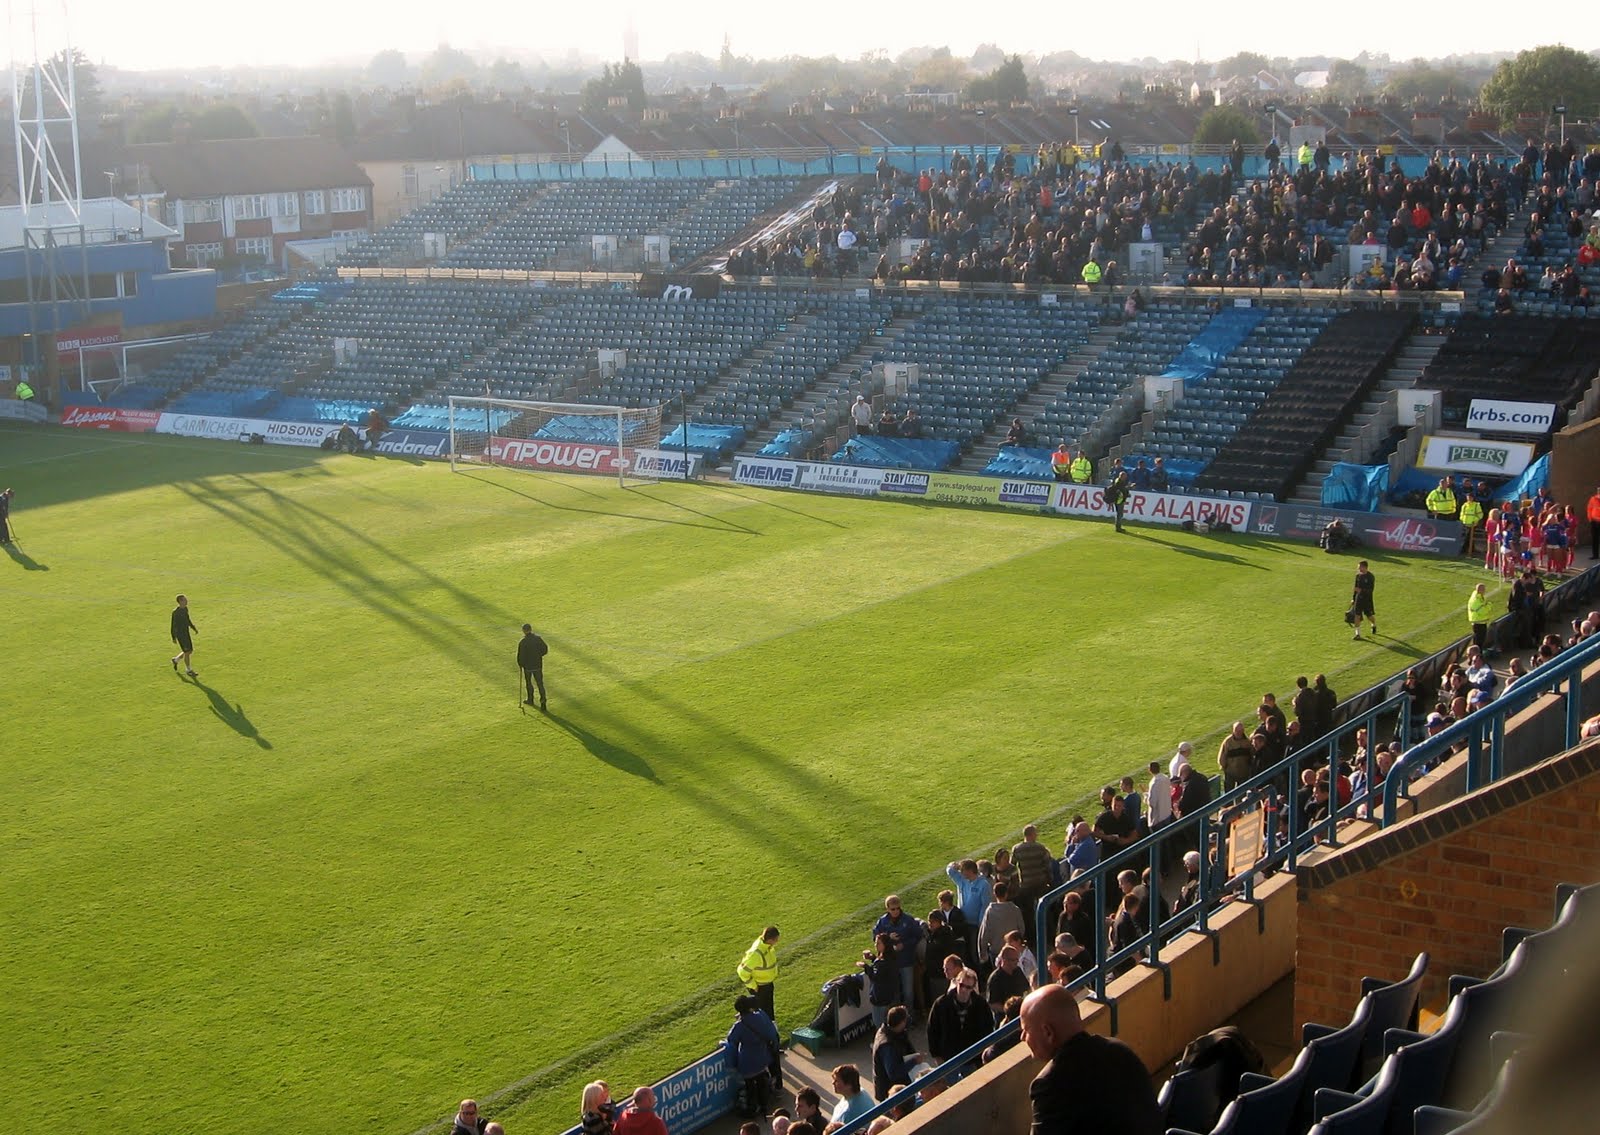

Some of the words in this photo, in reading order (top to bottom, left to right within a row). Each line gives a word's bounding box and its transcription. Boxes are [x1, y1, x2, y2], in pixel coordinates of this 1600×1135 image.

[1469, 406, 1549, 425] krbs.com
[267, 423, 324, 437] HIDSONS
[638, 456, 692, 474] MEMS
[739, 464, 794, 482] MEMS
[884, 472, 905, 483] STAY
[906, 474, 929, 486] LEGAL
[933, 482, 996, 493] www.staylegal.net
[1002, 482, 1025, 494] STAY
[1025, 484, 1050, 496] LEGAL
[1058, 487, 1146, 516] MASR
[1151, 497, 1246, 526] ALARMS
[661, 1075, 693, 1102] New
[696, 1058, 726, 1084] Hom
[659, 1090, 702, 1121] Victory
